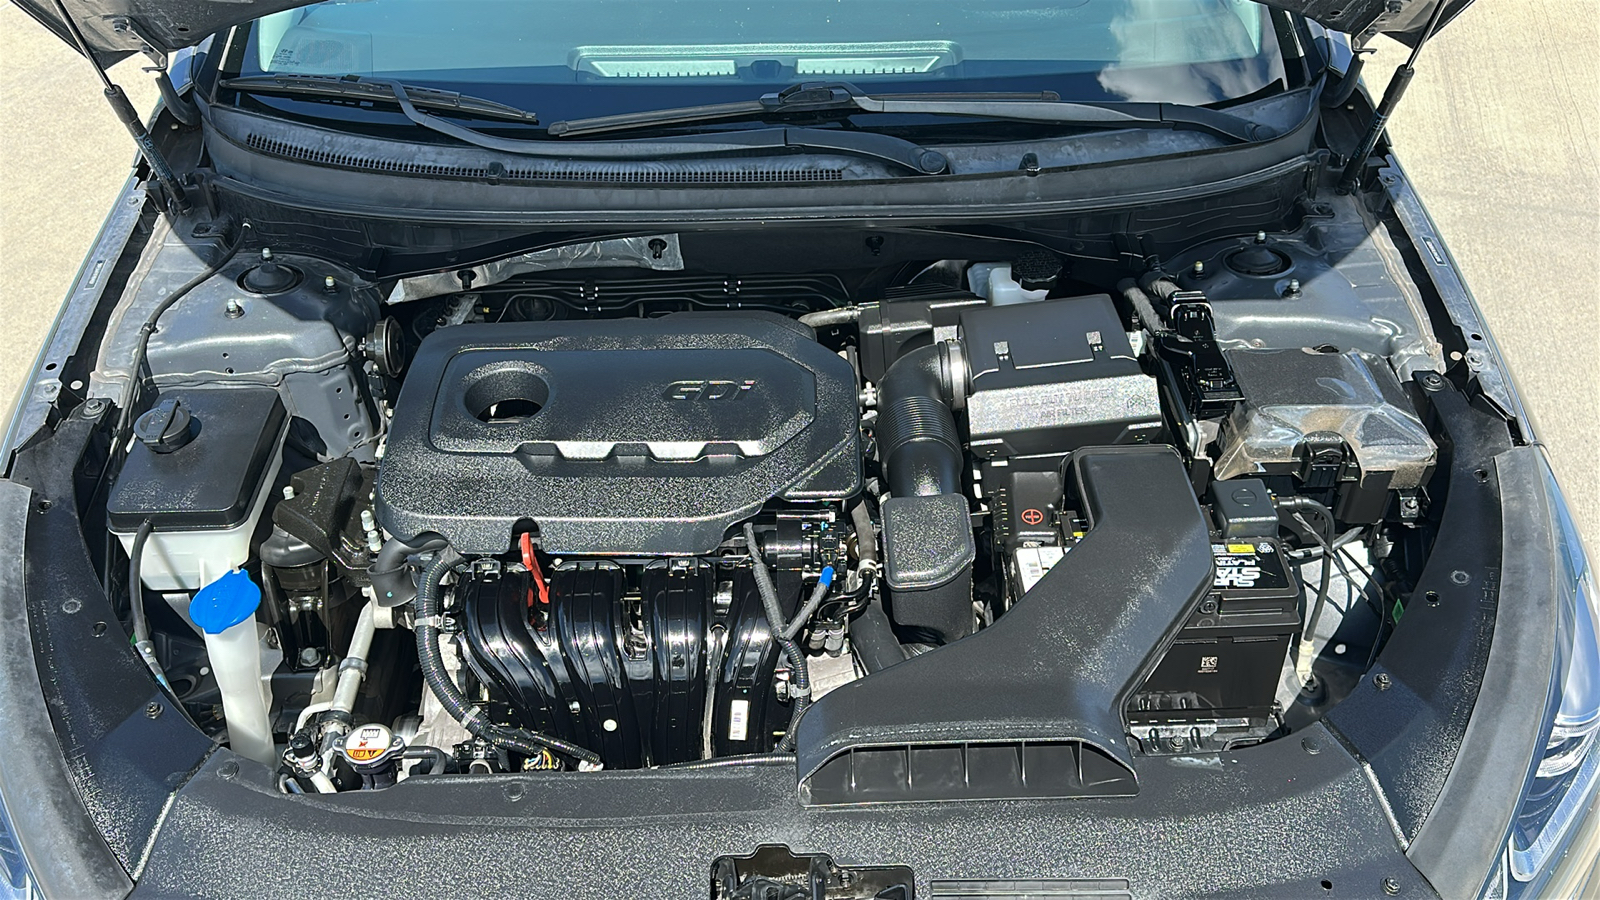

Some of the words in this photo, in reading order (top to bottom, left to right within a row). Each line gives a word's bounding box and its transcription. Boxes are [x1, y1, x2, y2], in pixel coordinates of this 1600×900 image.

[1057, 406, 1088, 417] FILTER
[1216, 567, 1261, 580] STA
[1214, 577, 1255, 587] SUP
